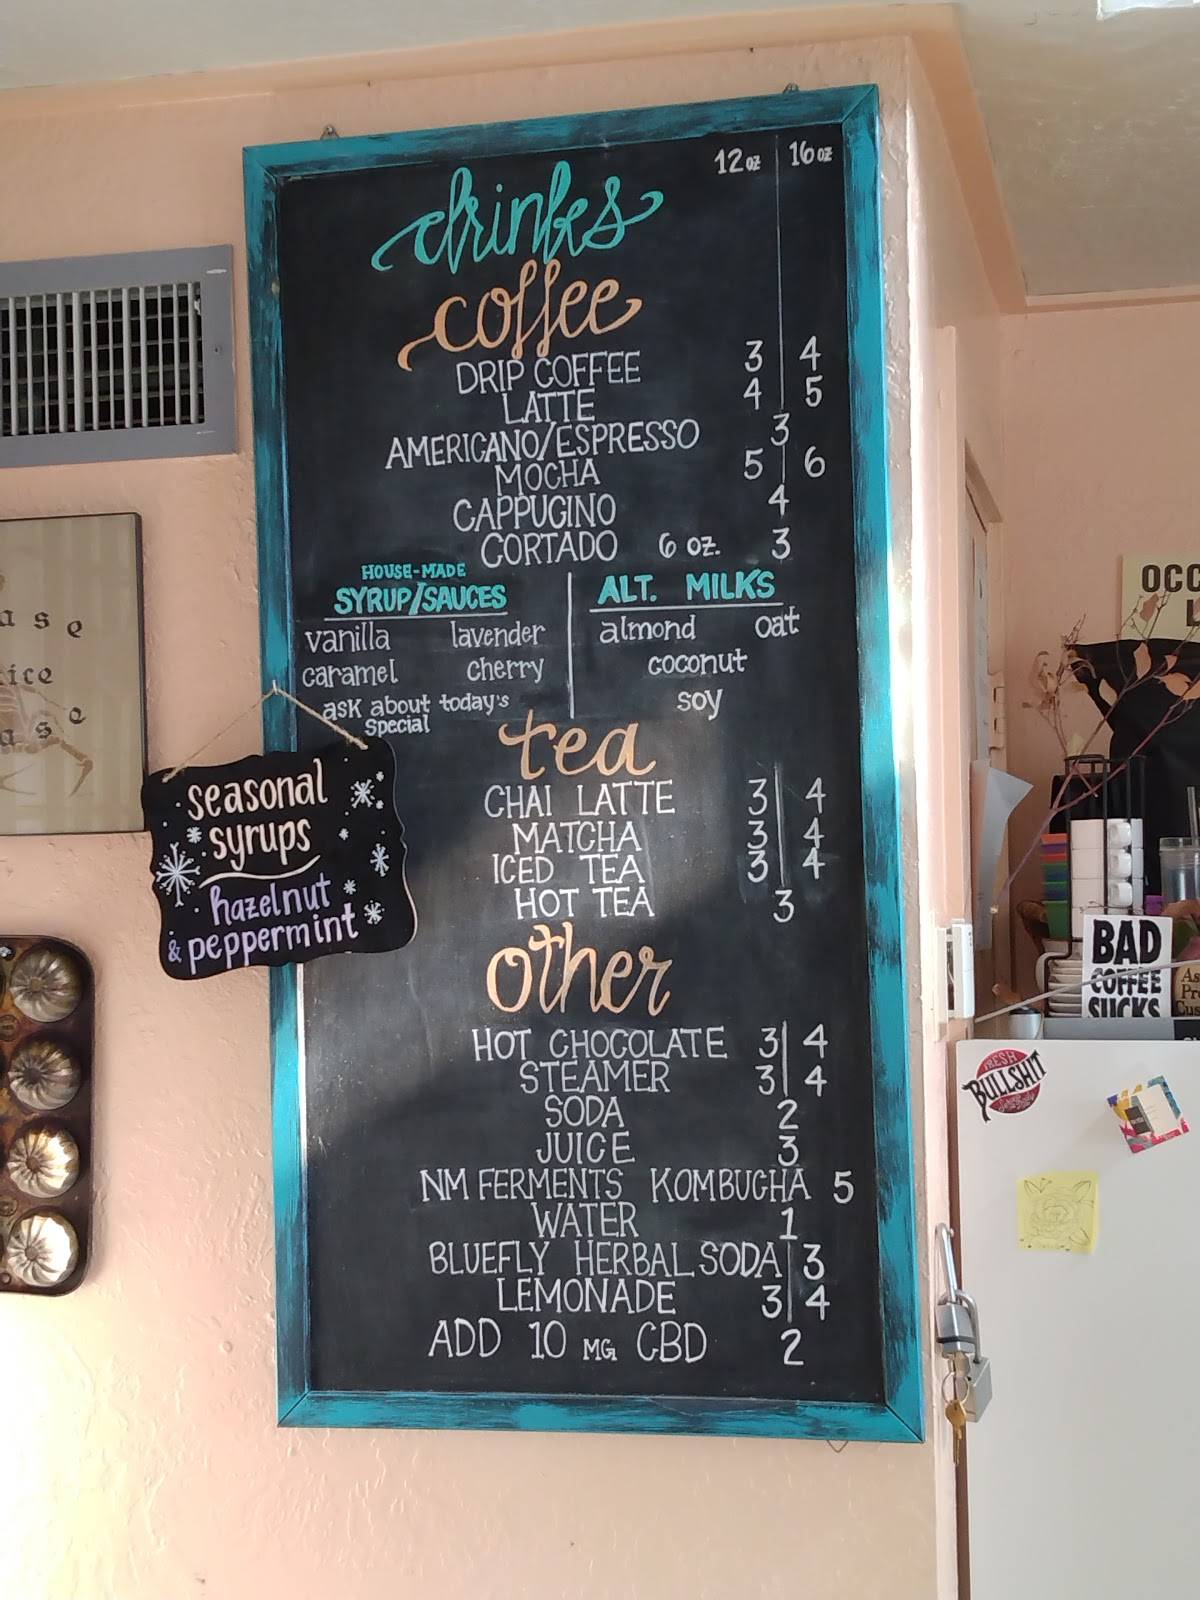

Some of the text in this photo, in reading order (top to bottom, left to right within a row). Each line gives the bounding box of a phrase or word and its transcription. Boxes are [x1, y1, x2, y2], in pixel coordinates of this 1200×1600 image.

[371, 160, 664, 274] drinks
[398, 259, 642, 371] coffee
[456, 336, 821, 395] DRIP COFFEE 3 4
[503, 376, 823, 424] LATTE 4 5
[385, 413, 790, 469] AMERICANO/ESPRESSO 3
[494, 446, 826, 496] MOCHA 5 6
[768, 485, 790, 518] 4
[480, 530, 618, 568] CORTADO
[659, 533, 677, 558] 6
[771, 528, 791, 559] 3
[361, 562, 466, 581] HOUSE-MADE
[598, 568, 775, 605] ALT. MILKS
[334, 582, 507, 616] SYRUP/SAUCES
[305, 620, 546, 653] vanilla lavender
[600, 607, 800, 644] almond oat
[0, 664, 54, 686] ice
[302, 656, 544, 688] caramel cherry
[648, 648, 747, 677] coconut
[322, 692, 510, 721] ask about today's
[677, 686, 723, 720] soy
[498, 708, 656, 780] tea
[187, 757, 328, 820] seasonal
[484, 777, 826, 819] CHAI LATTE 3 4
[208, 818, 311, 871] syrups
[512, 817, 825, 855] MATCHA 3 4
[493, 847, 825, 884] ICED TEA 3 4
[209, 872, 331, 926] hazelnut
[514, 886, 795, 923] HOT TEA 3
[167, 902, 359, 976] & peppermint
[1092, 919, 1162, 965] BAD
[486, 921, 673, 1017] other
[1090, 967, 1162, 996] COFFEE
[472, 1023, 829, 1062] HOT CHOCOLATE 3 4
[519, 1060, 828, 1097] STEAMER 3 4
[961, 1049, 1047, 1123] BULLSHIT
[544, 1096, 799, 1130] SODA 2
[536, 1131, 799, 1167] JUICE 3
[420, 1168, 469, 1202] NM
[479, 1168, 623, 1200] FERMENTS
[833, 1170, 854, 1204] 5
[531, 1202, 799, 1240] WATER 1
[428, 1240, 825, 1281] BLUEFLY HERBAL SODA 3
[498, 1277, 830, 1320] LEMONADE 3 4
[428, 1316, 804, 1366] ADD 10 MG CBD 2
